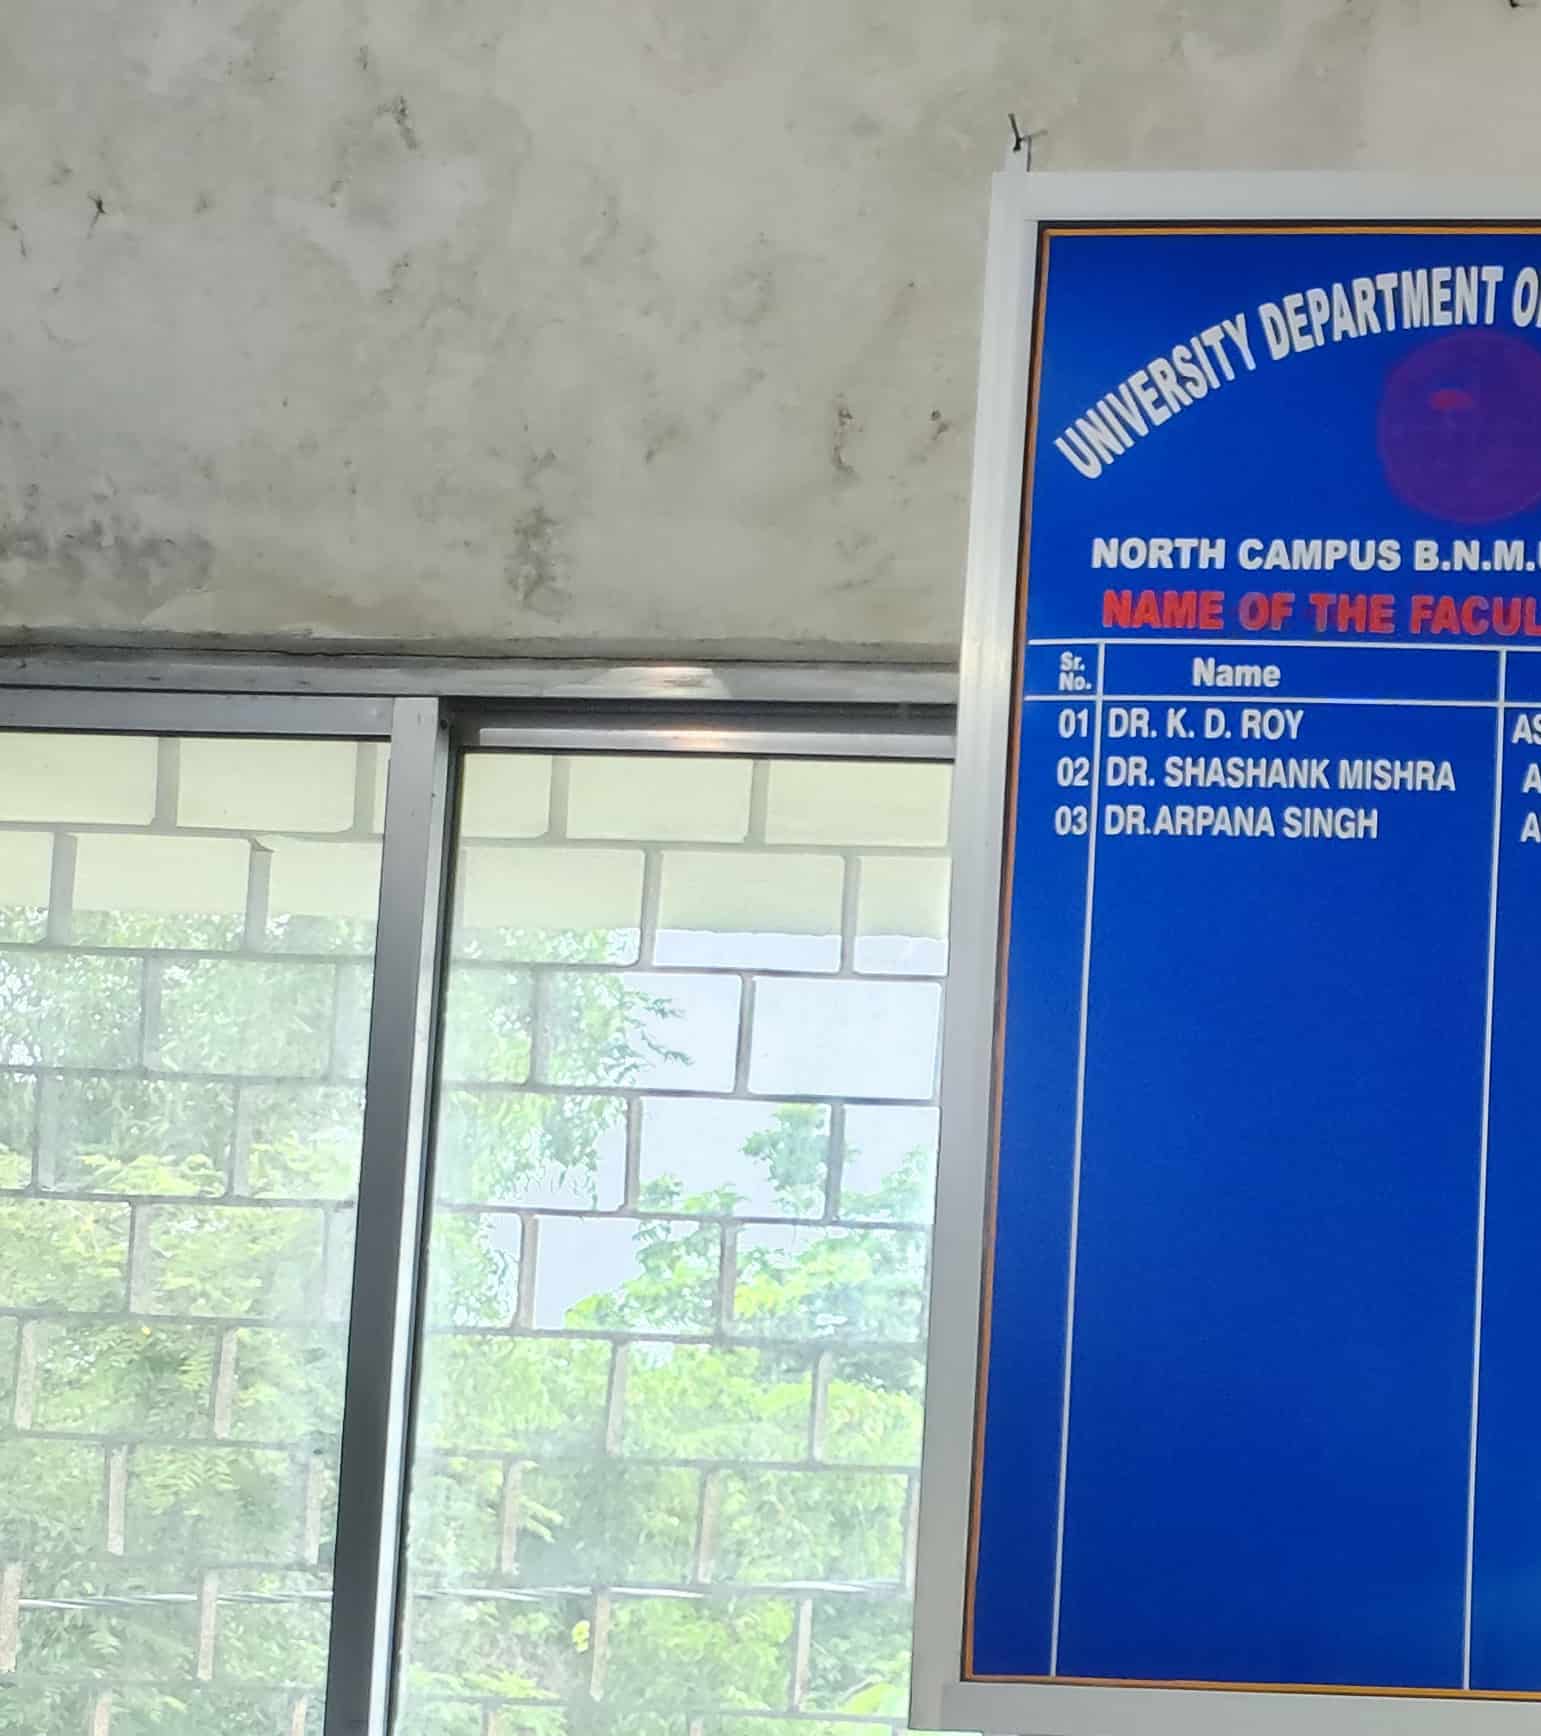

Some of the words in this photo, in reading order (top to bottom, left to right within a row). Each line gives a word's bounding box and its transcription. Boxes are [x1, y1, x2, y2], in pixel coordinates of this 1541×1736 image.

[1054, 312, 1250, 481] UNIVERSITY
[1259, 265, 1502, 360] DEPARTMENT
[1092, 538, 1225, 569] NORTH
[1239, 539, 1400, 571] CAMPUS
[1103, 590, 1224, 629] NAME
[1239, 592, 1294, 630] OF
[1310, 593, 1394, 633] THE
[1061, 652, 1084, 671] Sr.
[1193, 658, 1280, 687] Name
[1059, 672, 1091, 691] No.
[1059, 709, 1088, 738] 01
[1109, 708, 1156, 737] DR.
[1167, 708, 1194, 737] K.
[1205, 708, 1231, 738] D.
[1242, 709, 1303, 739] ROY
[1057, 757, 1089, 786] 02
[1107, 756, 1154, 786] DR.
[1165, 756, 1329, 789] SHASHANK
[1339, 760, 1455, 791] MISHRA
[1055, 806, 1087, 835] 03
[1283, 807, 1377, 839] SINGH
